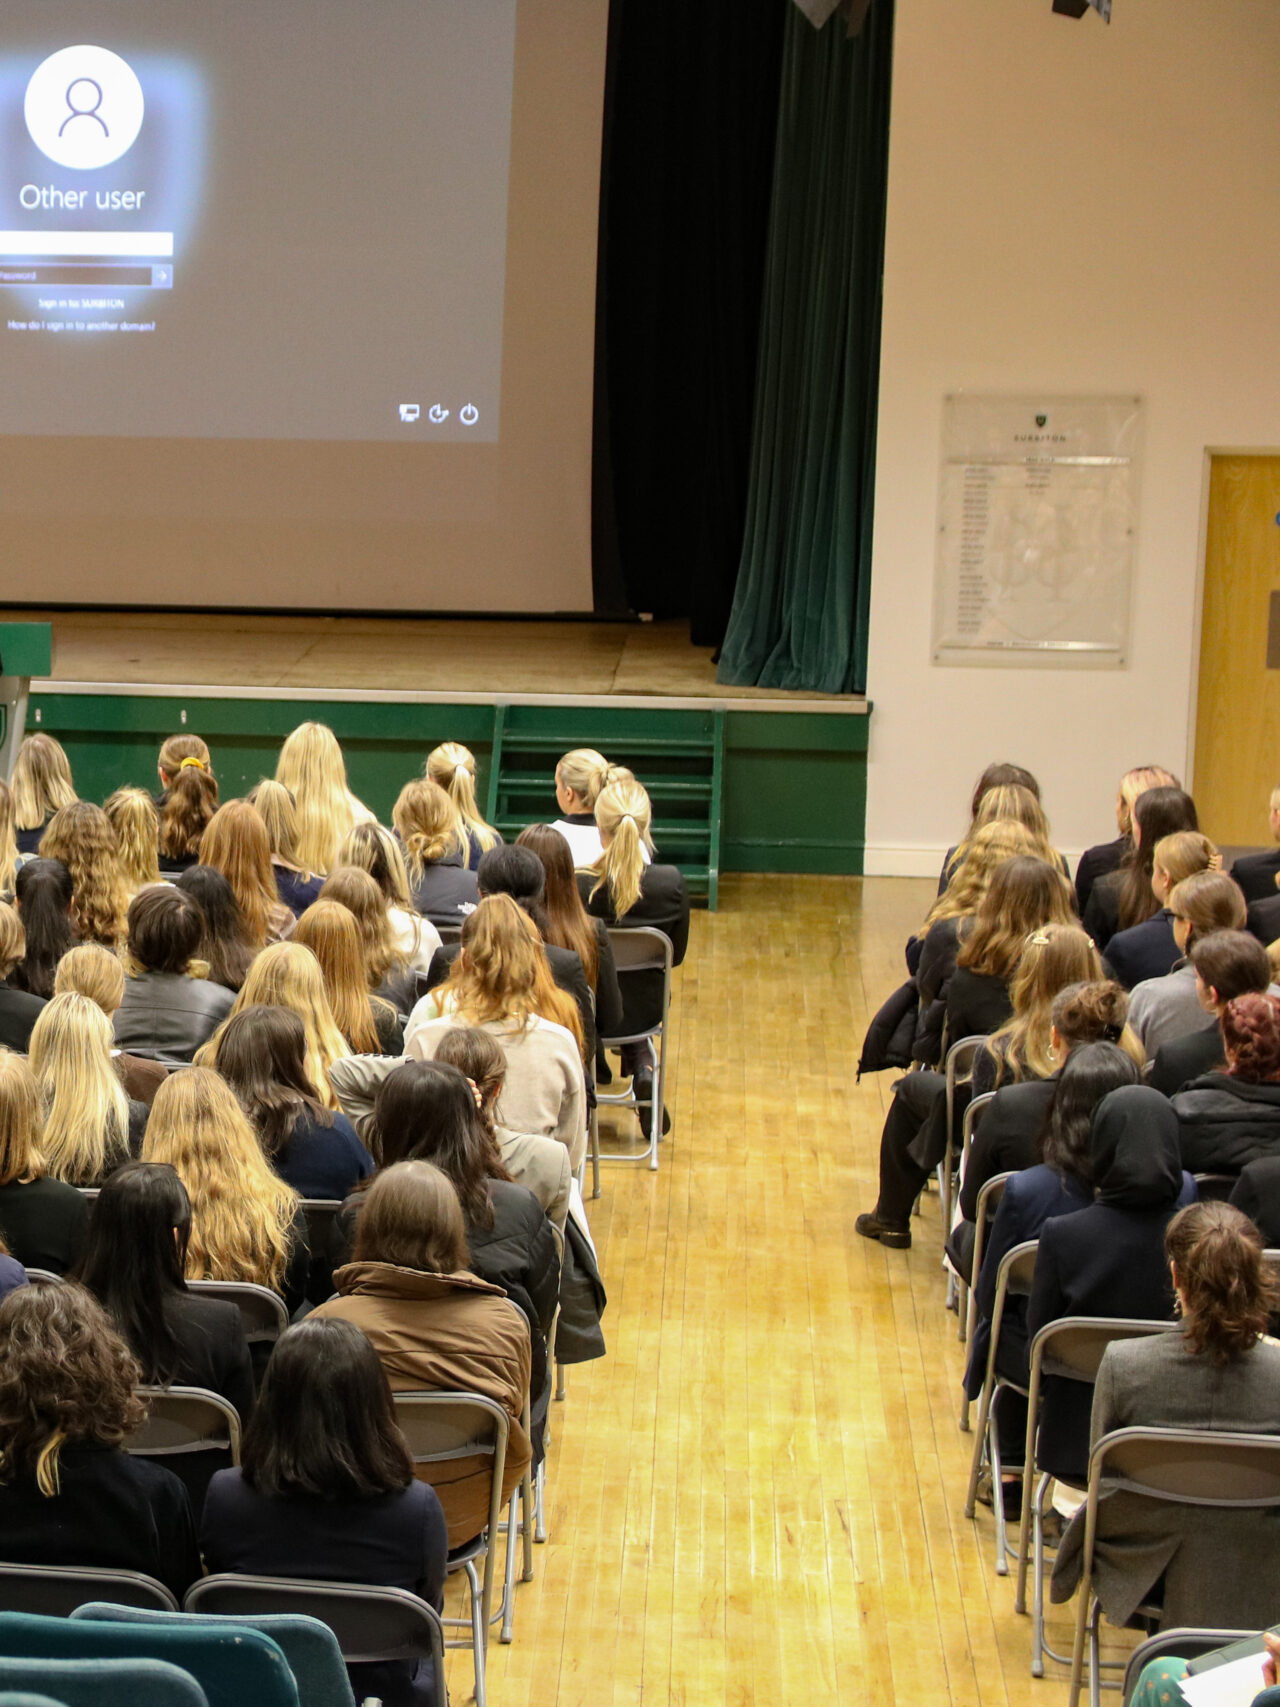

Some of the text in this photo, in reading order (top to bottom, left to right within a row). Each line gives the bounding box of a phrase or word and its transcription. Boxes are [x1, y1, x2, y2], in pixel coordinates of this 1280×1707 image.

[19, 184, 145, 210] Other user
[38, 298, 57, 310] Sign
[7, 320, 27, 331] How
[28, 321, 40, 331] do
[47, 321, 65, 333] sign
[75, 321, 85, 331] to
[86, 321, 119, 332] another
